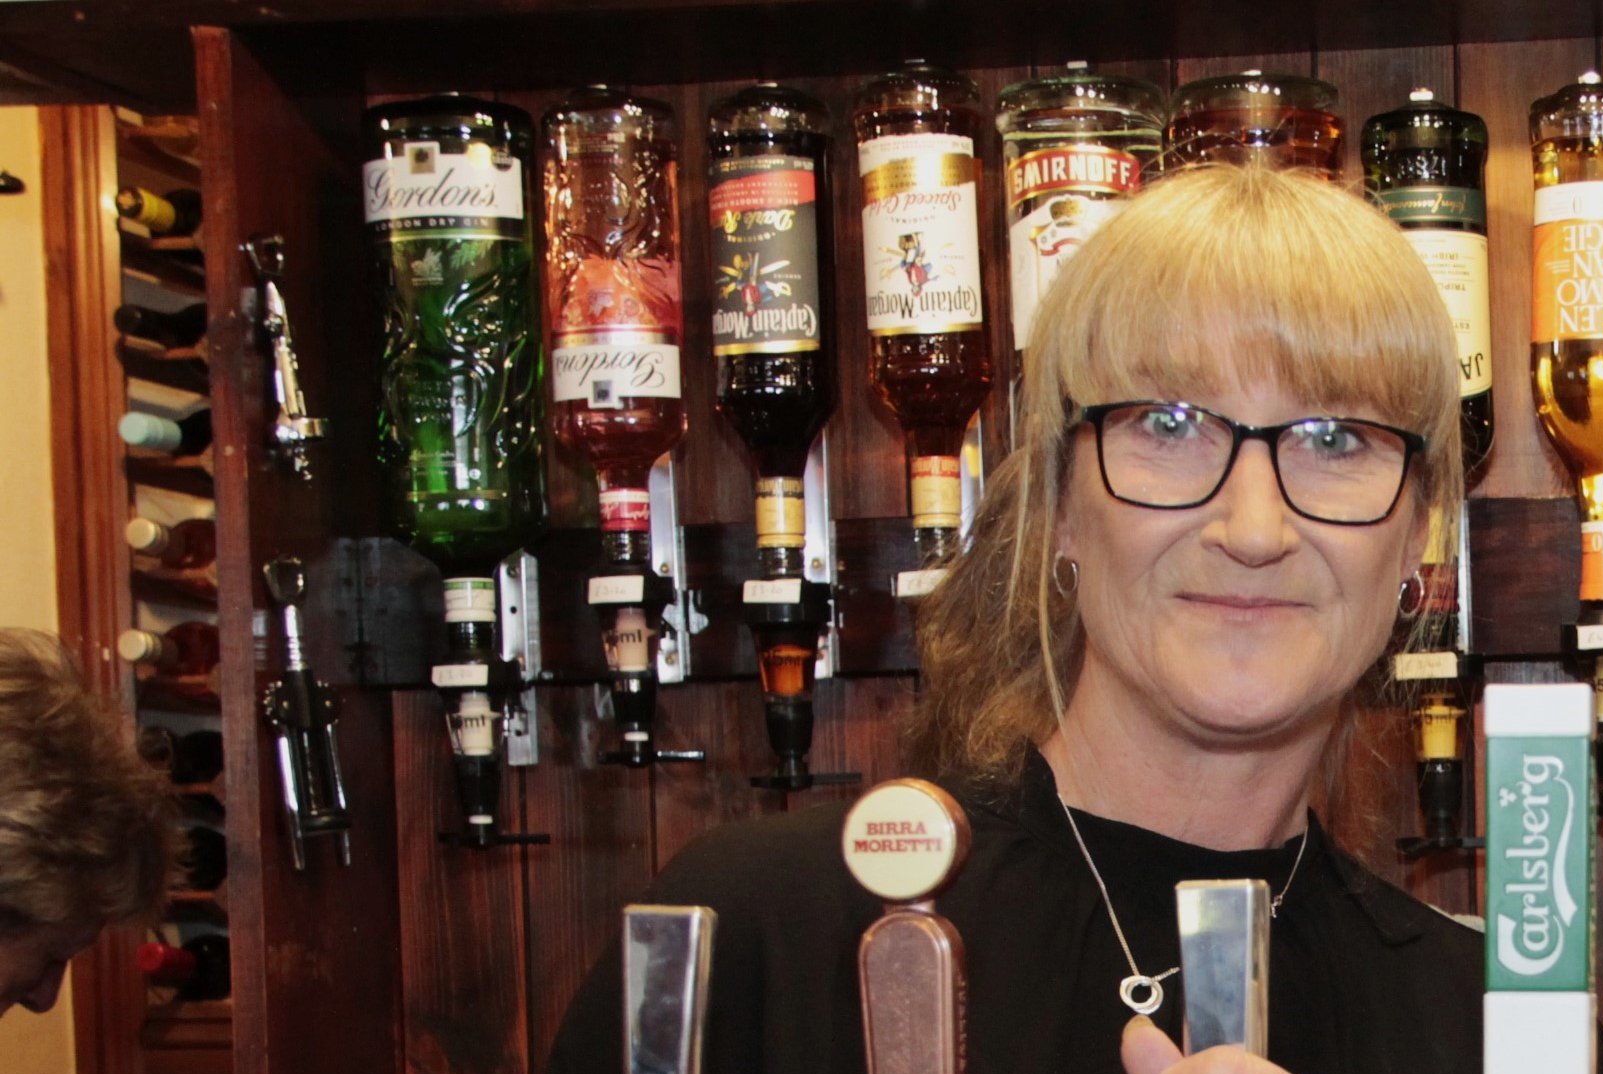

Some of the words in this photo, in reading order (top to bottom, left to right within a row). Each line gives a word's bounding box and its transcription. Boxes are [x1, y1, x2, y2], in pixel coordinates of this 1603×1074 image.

[368, 167, 497, 214] Gordon's
[1014, 153, 1131, 195] SMIRNOFF
[903, 191, 962, 212] Spiced
[919, 286, 978, 318] Captain
[753, 303, 817, 338] Captain
[866, 822, 927, 835] BIRRA
[854, 839, 942, 853] MORETTI
[1498, 754, 1577, 975] Carlsberg
